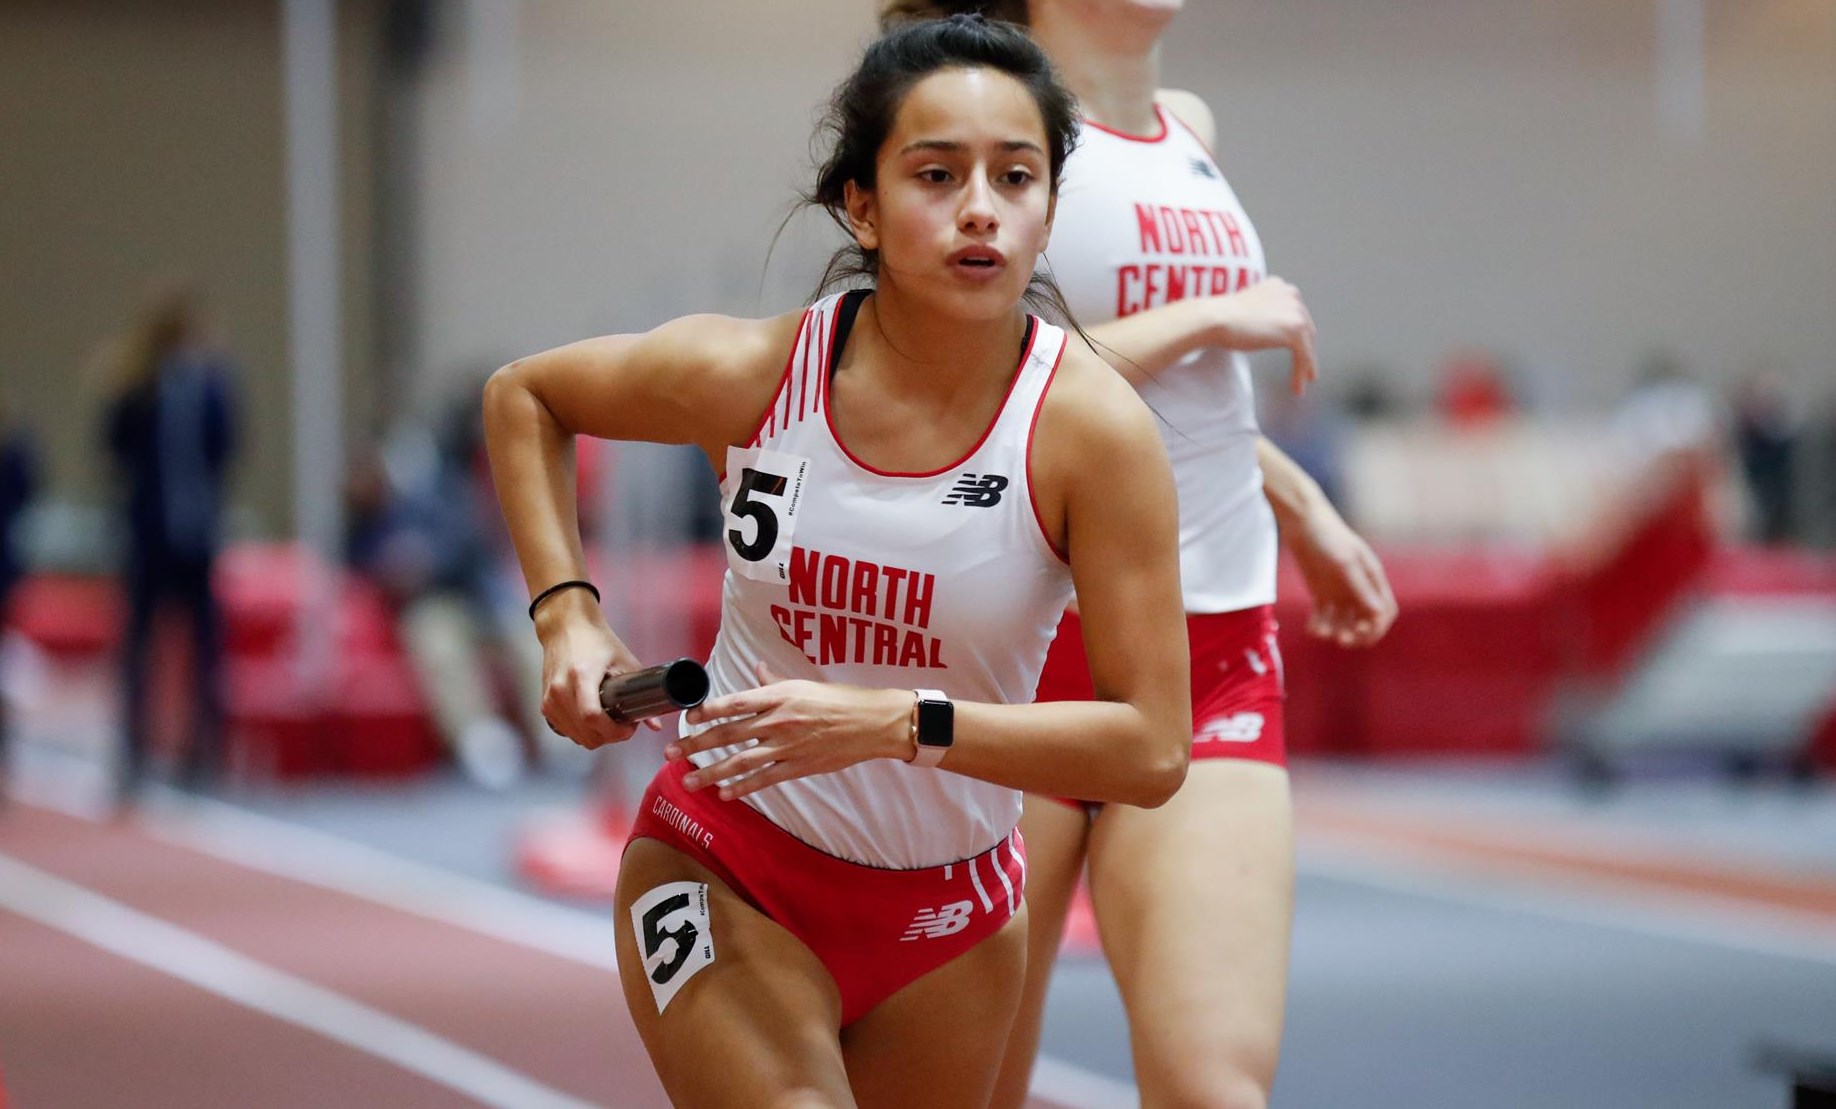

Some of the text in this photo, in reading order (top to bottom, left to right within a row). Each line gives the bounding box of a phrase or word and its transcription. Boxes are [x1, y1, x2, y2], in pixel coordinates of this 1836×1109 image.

[1134, 202, 1249, 258] NORTH
[1116, 264, 1260, 319] CENTRA
[728, 467, 788, 562] 5
[788, 546, 935, 629] NORTH
[770, 604, 948, 669] CENTRAL
[652, 795, 714, 849] CARDINALS
[642, 892, 699, 985] 5
